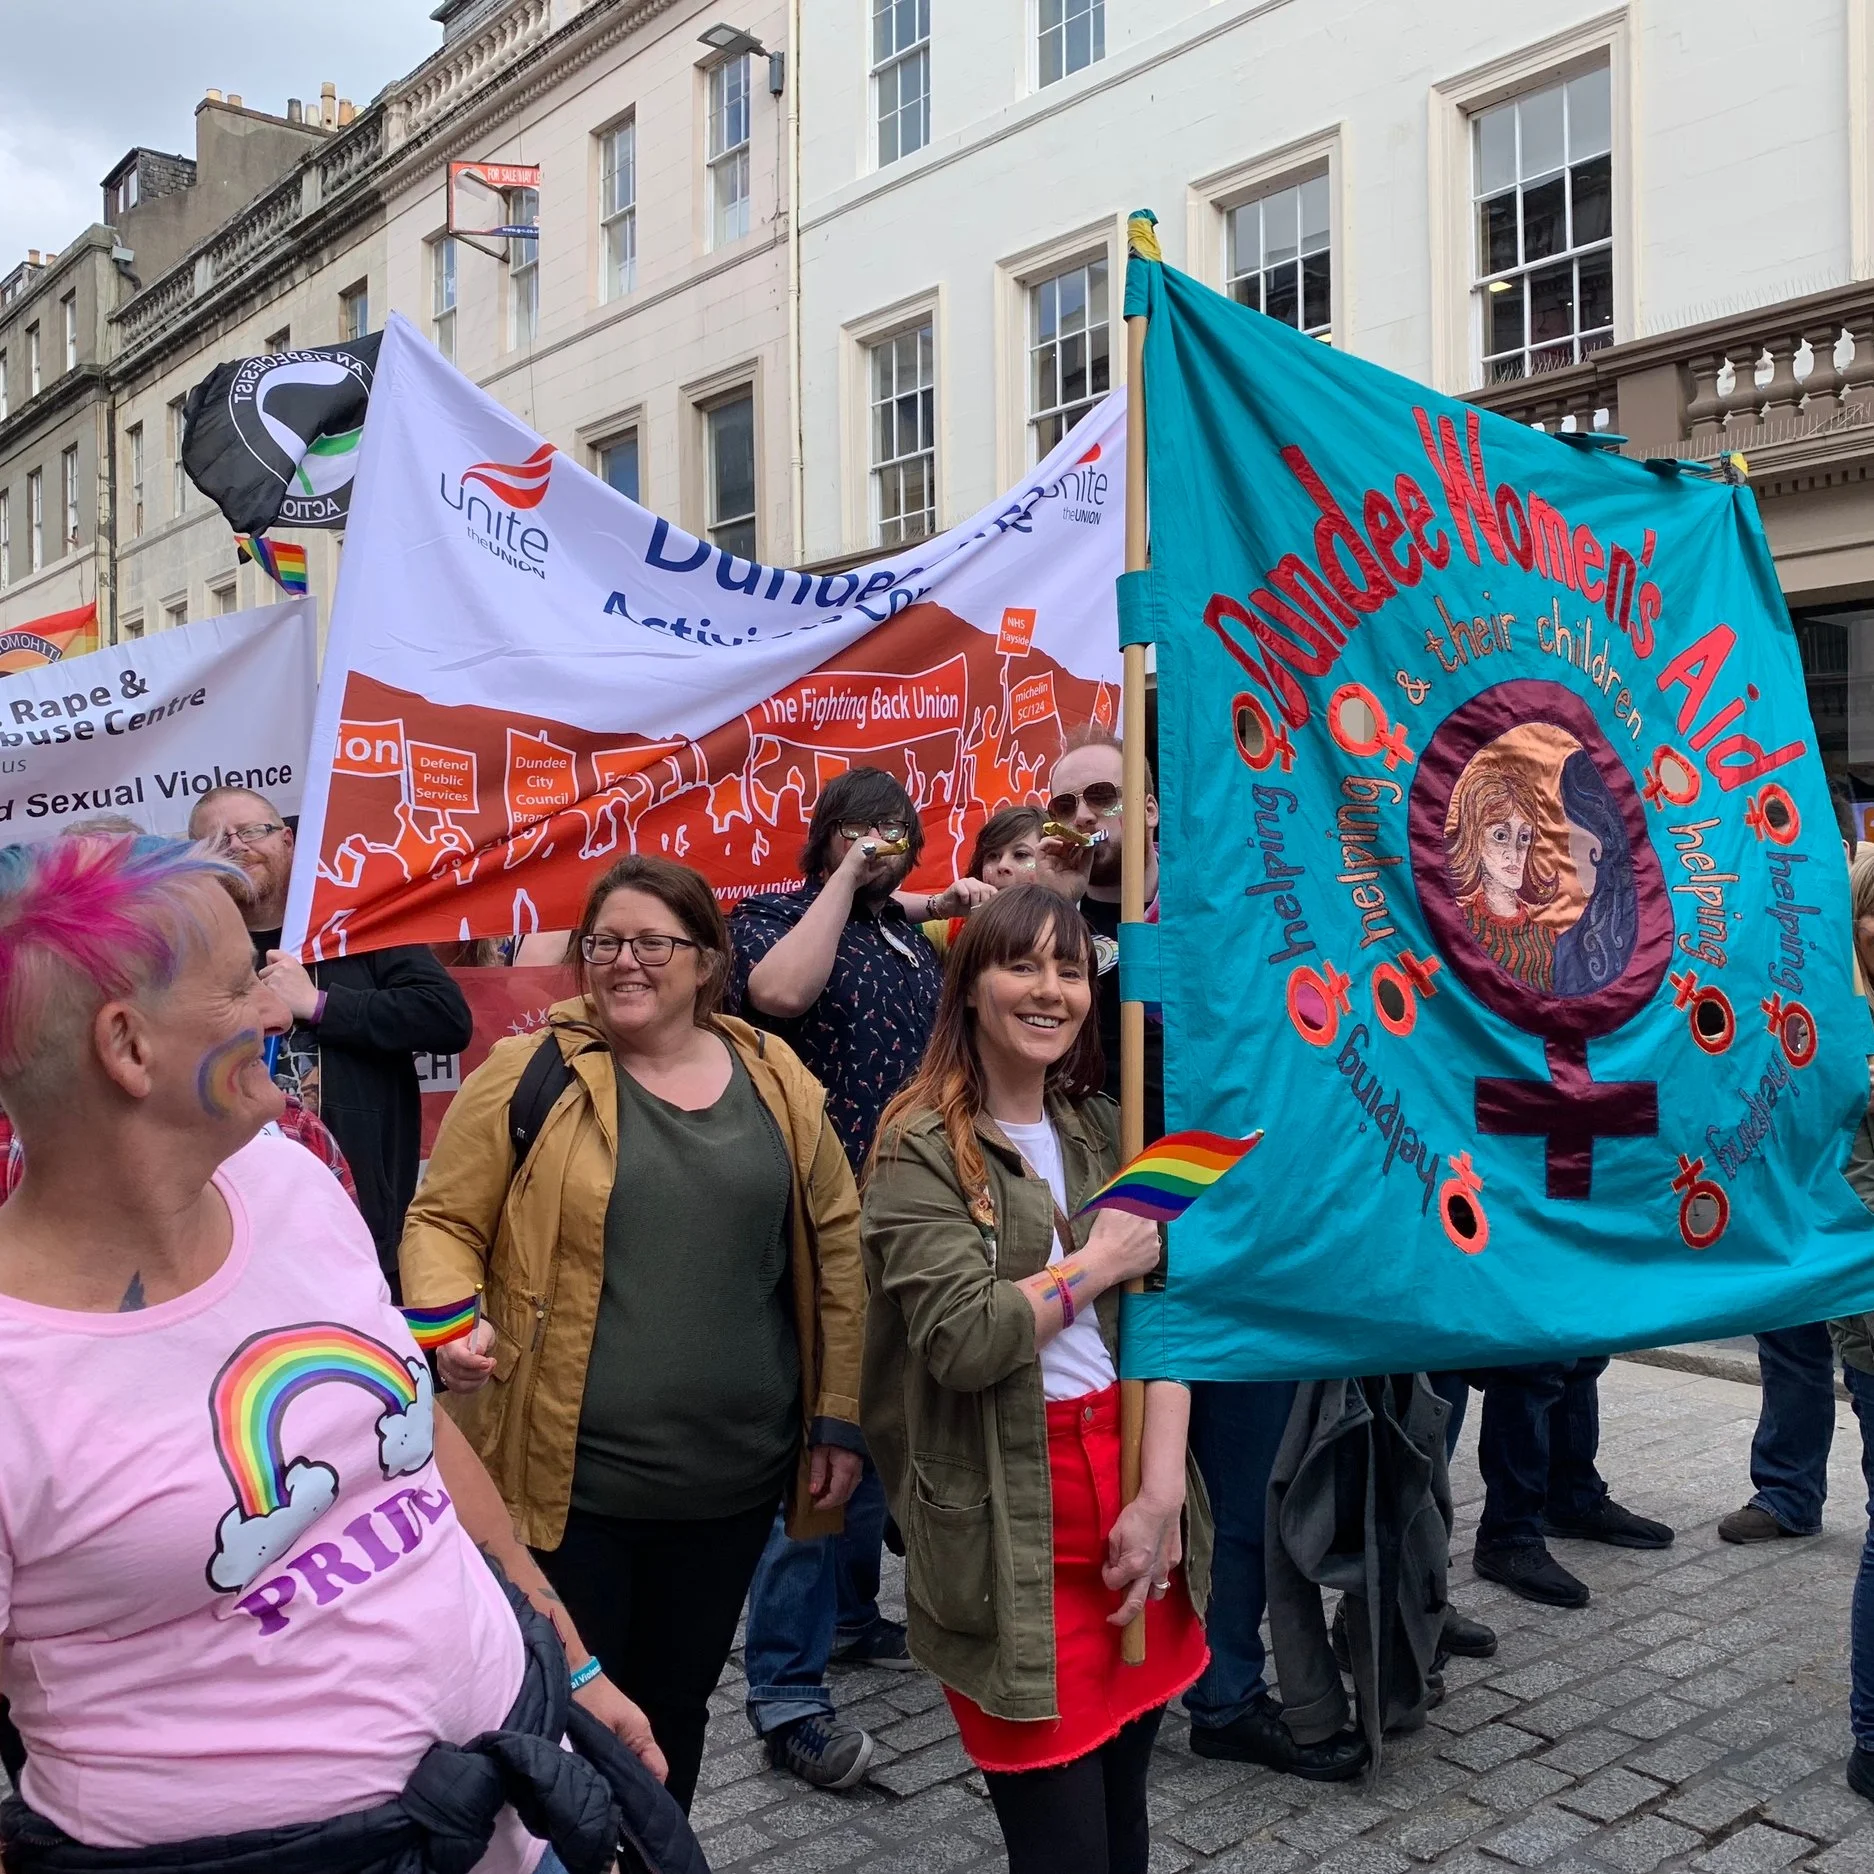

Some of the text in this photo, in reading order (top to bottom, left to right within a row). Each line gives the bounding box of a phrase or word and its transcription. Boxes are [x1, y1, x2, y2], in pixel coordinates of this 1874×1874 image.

[487, 167, 500, 181] FOR
[501, 168, 517, 182] SALE
[1203, 406, 1806, 793] Dundee Women's Aid
[1002, 630, 1030, 646] Tayside
[1007, 616, 1025, 630] NHS
[1395, 669, 1432, 705] &
[1424, 591, 1516, 673] their
[10, 669, 150, 725] Rape &
[800, 686, 869, 731] Fighting
[870, 685, 911, 720] Back
[912, 686, 959, 719] Union
[1015, 682, 1048, 703] michelin
[104, 687, 206, 736] Centre
[1017, 700, 1045, 721] SC/124
[420, 757, 469, 771] Defend
[515, 756, 567, 769] Dundee
[26, 777, 144, 818] Sexual
[154, 764, 292, 799] Violence
[415, 788, 469, 802] Services
[423, 773, 464, 786] Public
[526, 776, 554, 790] City
[515, 792, 569, 805] Council
[513, 811, 554, 823] Bran
[1245, 783, 1316, 965] helping
[1325, 775, 1403, 949] helping
[1668, 817, 1739, 969] helping
[1765, 851, 1821, 994] helping
[1337, 1023, 1440, 1217] helping
[1705, 1047, 1801, 1181] helping
